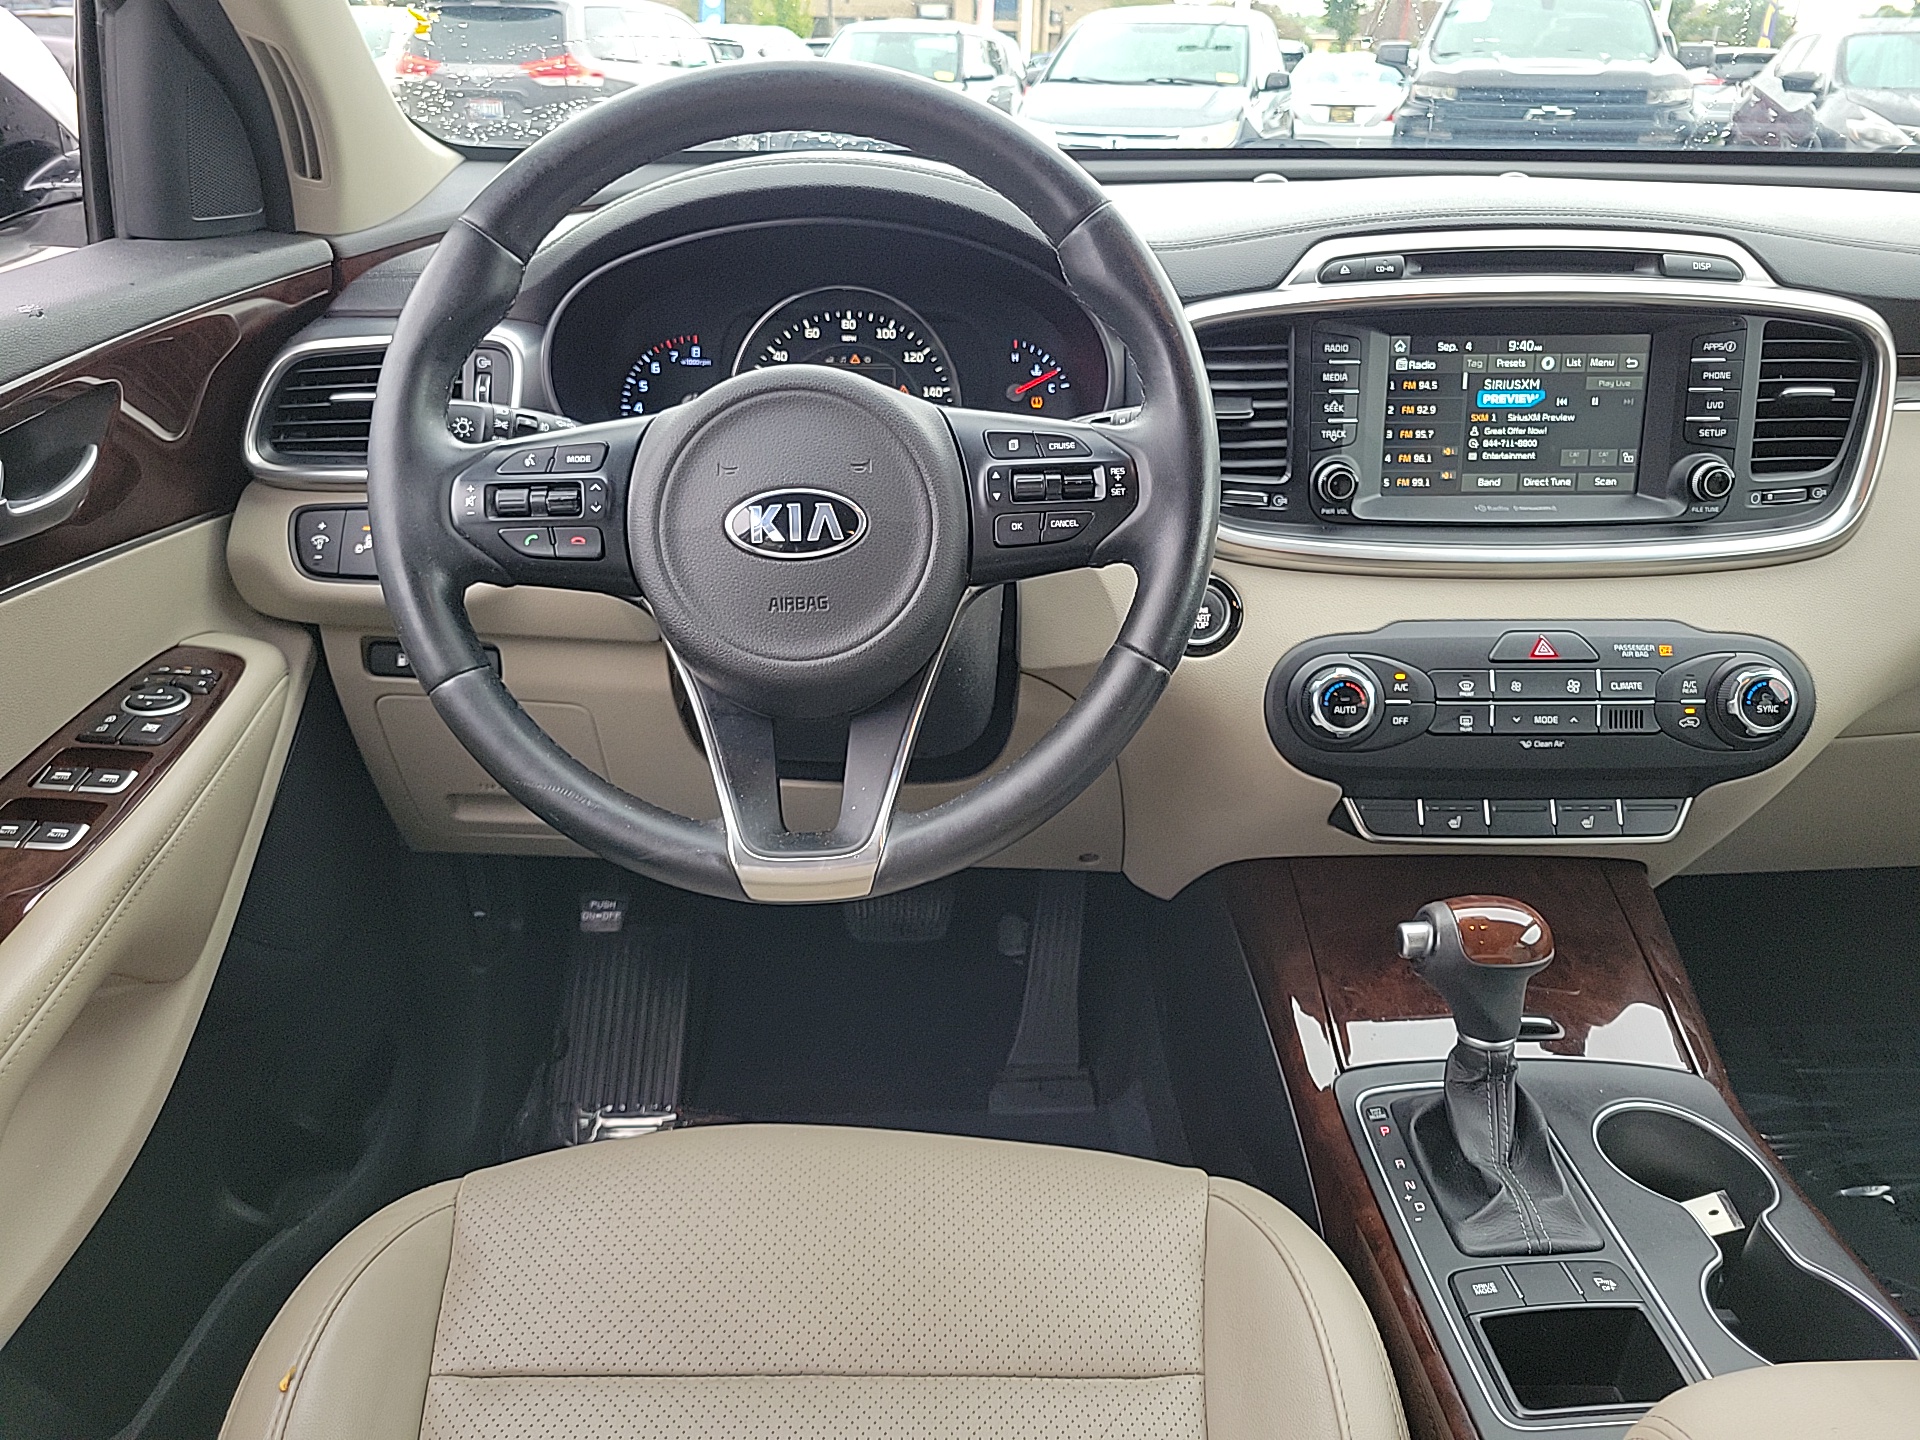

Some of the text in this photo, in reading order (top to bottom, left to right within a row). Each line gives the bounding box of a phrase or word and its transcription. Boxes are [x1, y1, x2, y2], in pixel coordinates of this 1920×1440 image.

[1693, 262, 1711, 271] DISP
[841, 319, 857, 330] 80
[805, 328, 820, 339] 60
[876, 328, 896, 339] 100
[1324, 344, 1349, 352] RADIO
[1438, 341, 1458, 352] Sep.
[1465, 341, 1473, 351] 4
[691, 346, 700, 357] 8
[669, 351, 679, 362] 7
[772, 351, 788, 362] 40
[903, 352, 924, 363] 120
[1010, 353, 1019, 362] H
[1409, 361, 1436, 370] Radio
[1467, 358, 1615, 369] Tag Presets List Menu
[651, 363, 660, 374] 6
[1322, 372, 1348, 381] MEDIA
[1703, 372, 1731, 380] PHONE
[638, 381, 648, 392] 5
[1048, 384, 1056, 393] C
[1389, 381, 1438, 390] 1 FM 94.5
[1484, 379, 1540, 390] SIRIUSXM
[923, 386, 943, 398] 140
[633, 402, 643, 413] 4
[1324, 404, 1344, 413] SEEK
[1388, 405, 1436, 415] 2 FM 92.9
[1706, 401, 1724, 410] UVO
[1470, 413, 1489, 422] SXM
[1491, 413, 1497, 422] 1
[1542, 413, 1575, 422] Preview
[1321, 430, 1346, 439] TRACK
[1386, 430, 1393, 439] 3
[1400, 430, 1413, 439] FM
[1484, 427, 1506, 435] Great
[1699, 429, 1727, 437] SETUP
[1049, 442, 1076, 450] CRUISE
[567, 455, 591, 463] MODE
[1385, 454, 1391, 463] 4
[1398, 454, 1412, 463] FM
[1482, 451, 1536, 460] Entertainment
[1110, 467, 1125, 475] RES
[1383, 478, 1390, 487] 5
[1396, 478, 1410, 487] FM
[1478, 477, 1617, 487] Band Direct Tune Scan
[1111, 488, 1126, 496] SET
[748, 503, 845, 543] KIA
[1051, 520, 1079, 528] CANCEL
[768, 596, 829, 612] AIRBAG
[1613, 644, 1655, 652] PASSENGER
[1621, 650, 1634, 658] AIR
[1394, 683, 1409, 692] A/C
[1610, 681, 1642, 691] CLIMATE
[1682, 680, 1697, 689] A/C
[1334, 705, 1357, 715] AUTO
[1756, 704, 1779, 714] SYNC
[1392, 716, 1409, 726] OFF
[1534, 715, 1559, 725] MODE
[1533, 740, 1565, 748] Clean Air
[590, 900, 617, 910] PUSH
[1380, 1126, 1390, 1137] P
[1395, 1159, 1405, 1169] R
[1405, 1181, 1417, 1190] N
[1414, 1202, 1425, 1212] D
[1472, 1282, 1496, 1290] DRIVE
[1474, 1286, 1498, 1296] MODE
